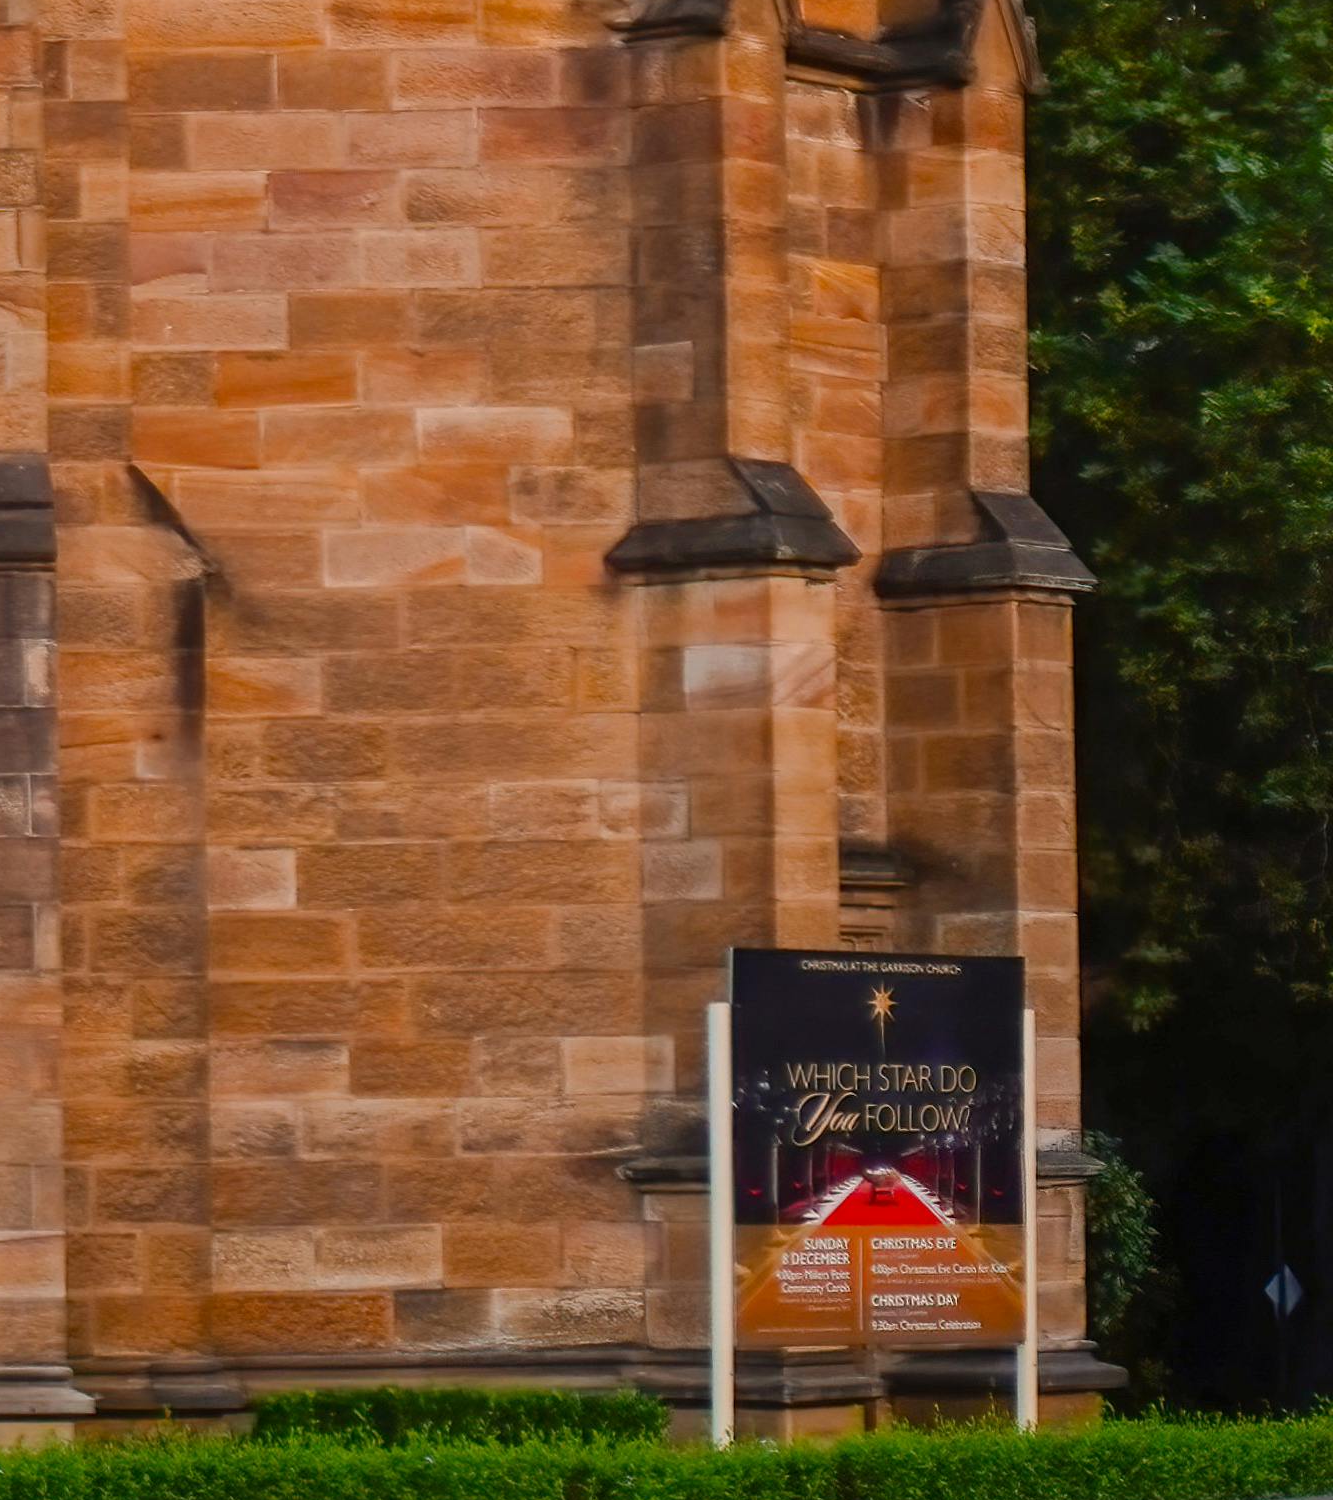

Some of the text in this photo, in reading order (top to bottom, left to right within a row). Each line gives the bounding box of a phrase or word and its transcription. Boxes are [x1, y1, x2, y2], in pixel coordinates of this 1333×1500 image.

[786, 1063, 977, 1093] WHICH STAR DO
[791, 1092, 970, 1147] You FOLLOW?
[804, 1238, 849, 1250] SUNDAY
[871, 1238, 957, 1249] CHRISTMAS EVE
[782, 1252, 850, 1265] 8 DECEMBER
[871, 1294, 960, 1306] CHRISTMAS DAY
